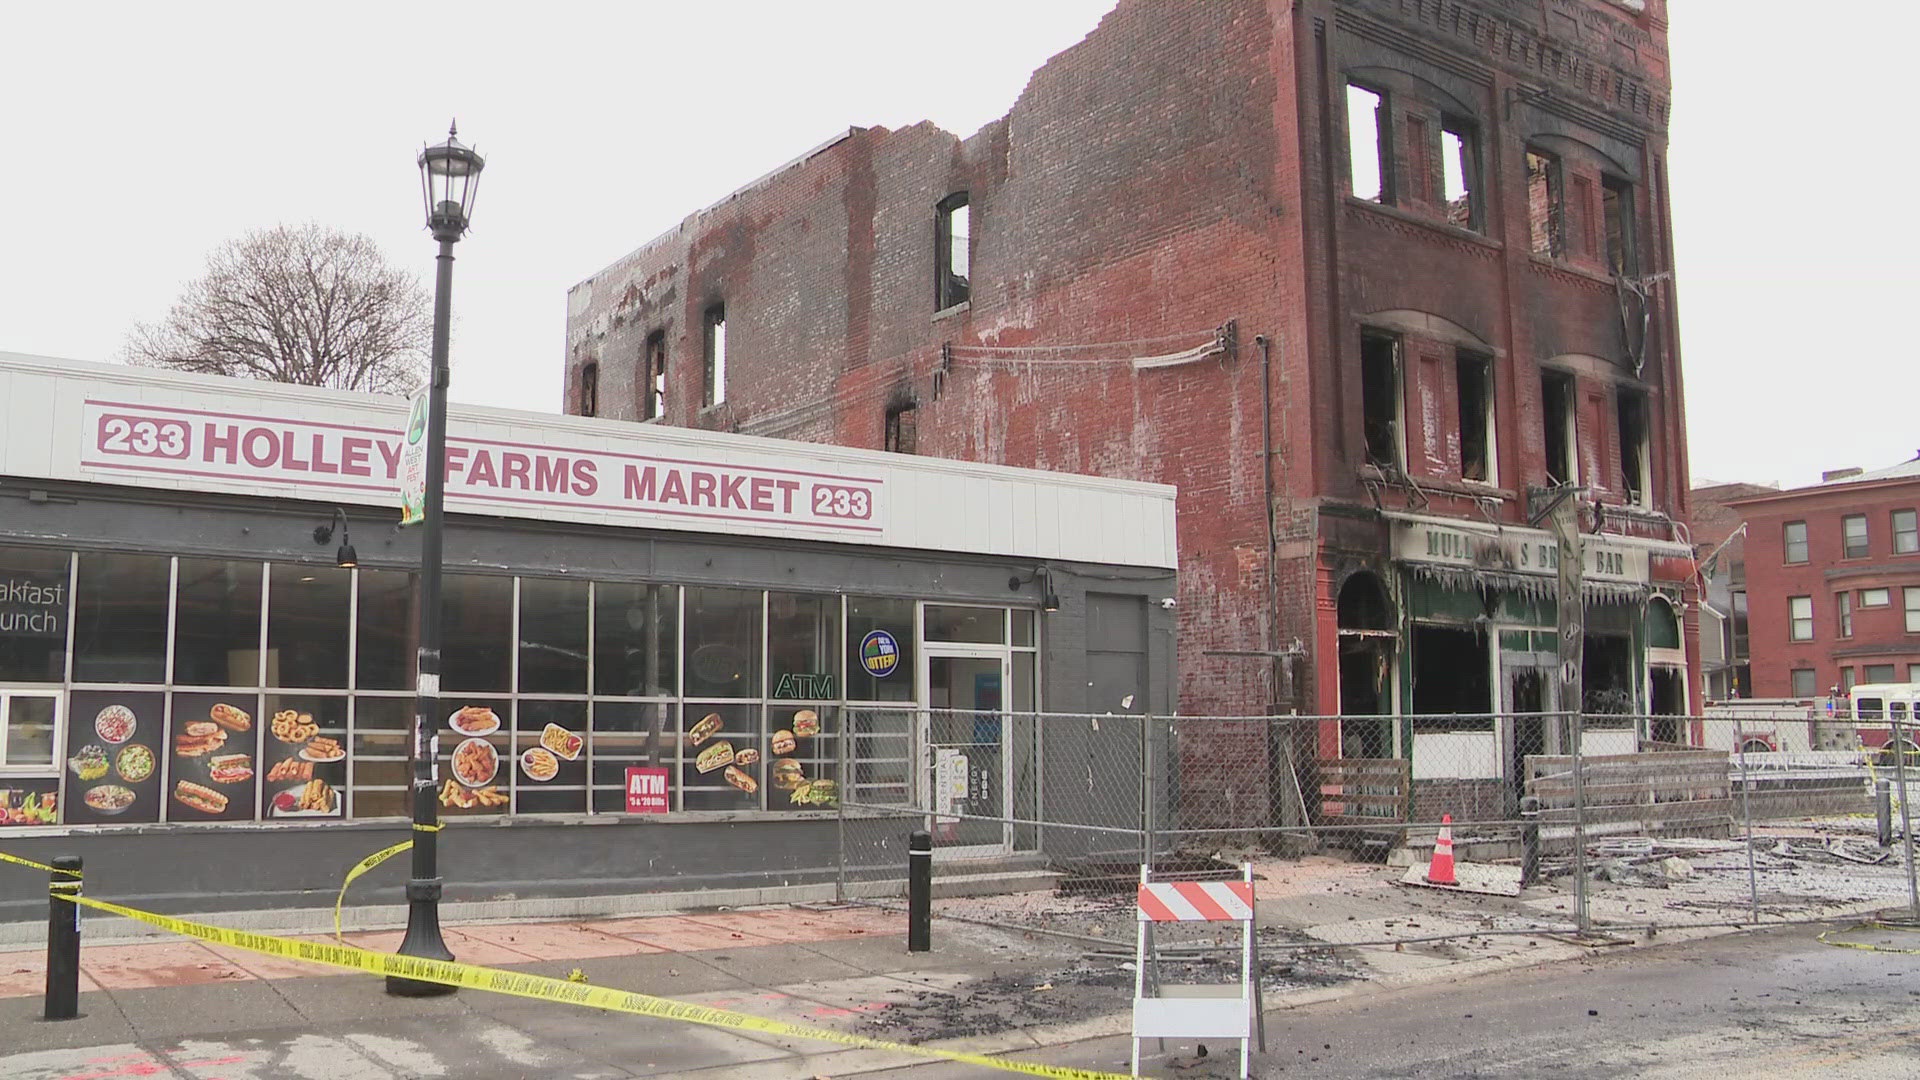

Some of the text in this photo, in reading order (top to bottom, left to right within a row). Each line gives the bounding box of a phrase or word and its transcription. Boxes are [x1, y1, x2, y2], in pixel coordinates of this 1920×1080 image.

[104, 418, 871, 518] 233 HOLLEY FARMS MARKET 233
[1596, 551, 1624, 575] BAR
[775, 673, 833, 699] ATM
[630, 774, 665, 795] ATM
